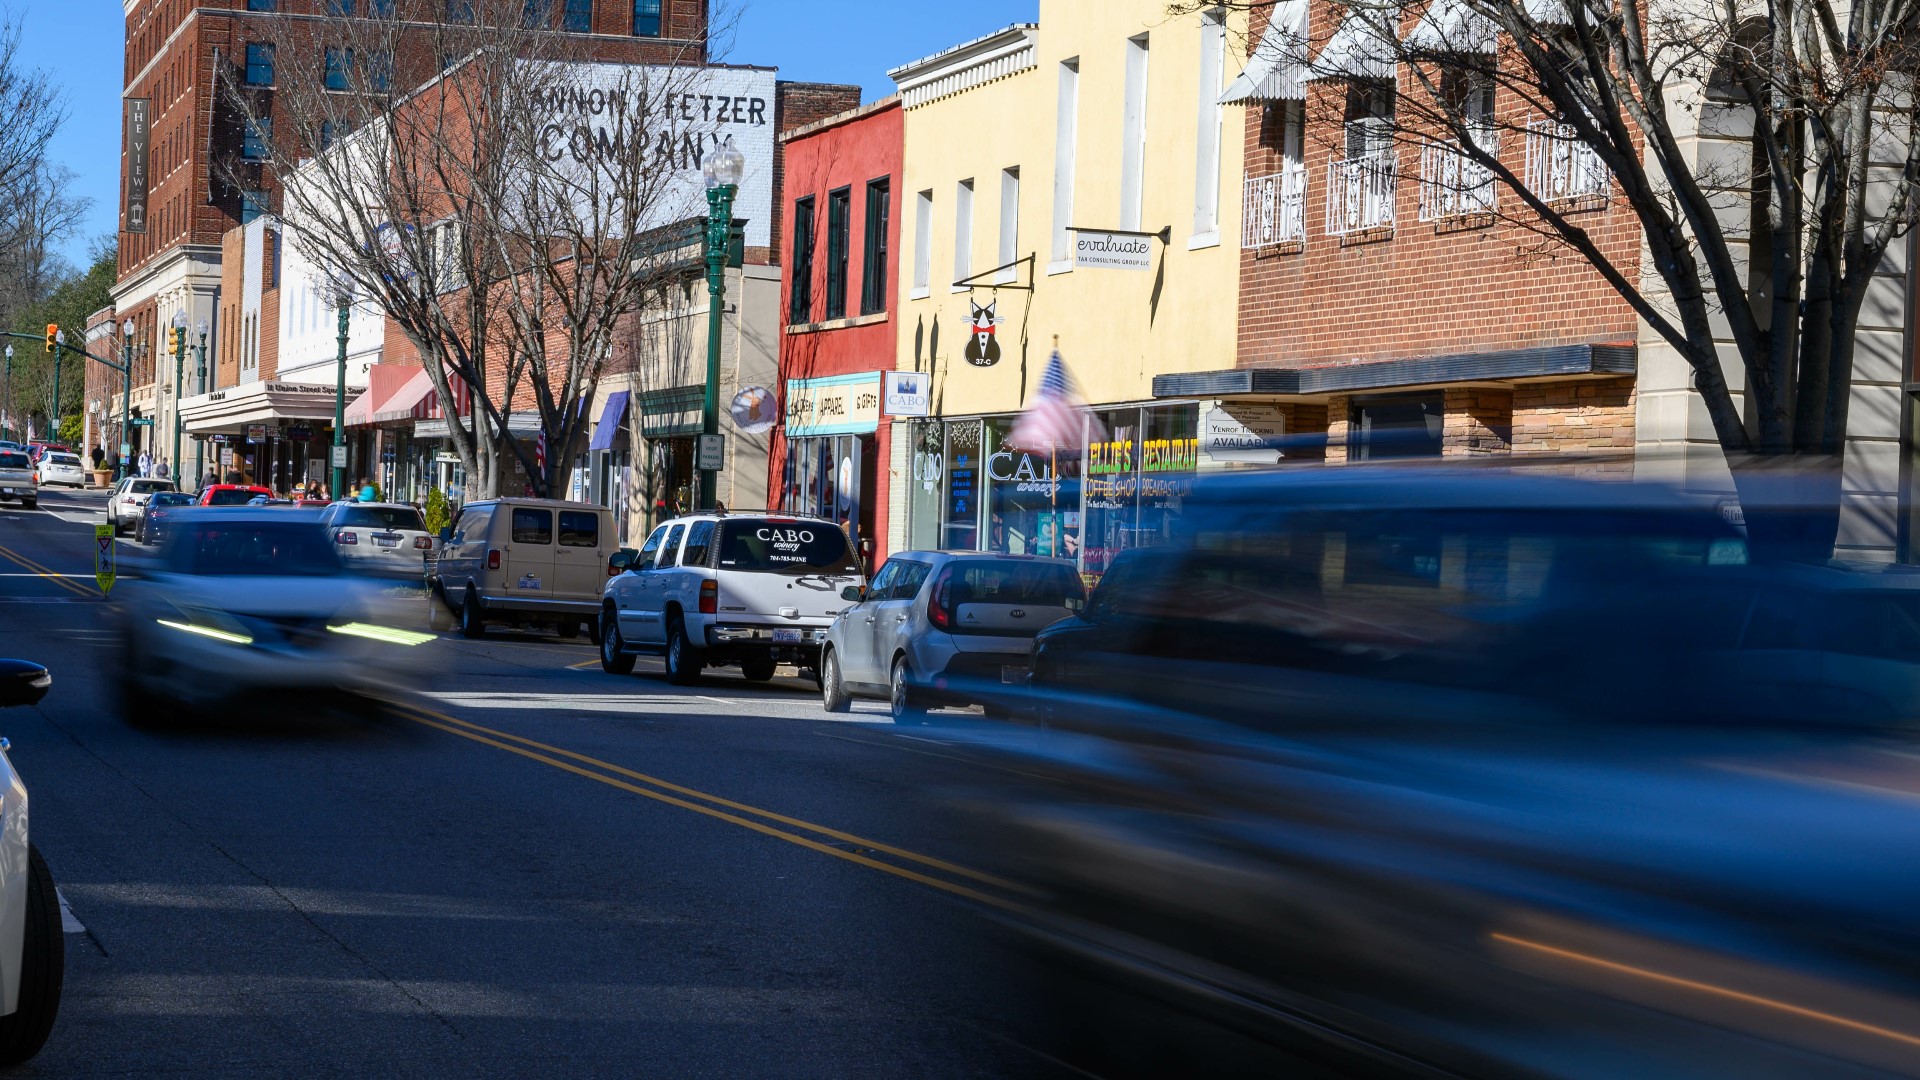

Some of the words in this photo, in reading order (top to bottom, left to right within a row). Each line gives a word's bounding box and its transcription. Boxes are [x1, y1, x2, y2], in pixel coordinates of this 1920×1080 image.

[133, 101, 143, 134] THE
[664, 93, 766, 125] FETZER
[540, 123, 734, 171] COMPANY
[132, 142, 145, 187] VIEW
[1077, 235, 1149, 254] evaluate
[975, 358, 992, 366] 37-C
[275, 384, 298, 393] Union
[299, 386, 321, 394] Street
[820, 396, 844, 417] APPAREL
[862, 393, 877, 409] GIFTS
[888, 395, 925, 406] CABO
[914, 453, 942, 480] CABO
[1089, 440, 1132, 473] ELLIE'S
[1016, 481, 1061, 497] winery
[1083, 478, 1113, 497] COFFEE
[1115, 477, 1136, 497] SHOP
[756, 528, 814, 543] CABO
[774, 542, 800, 552] winery
